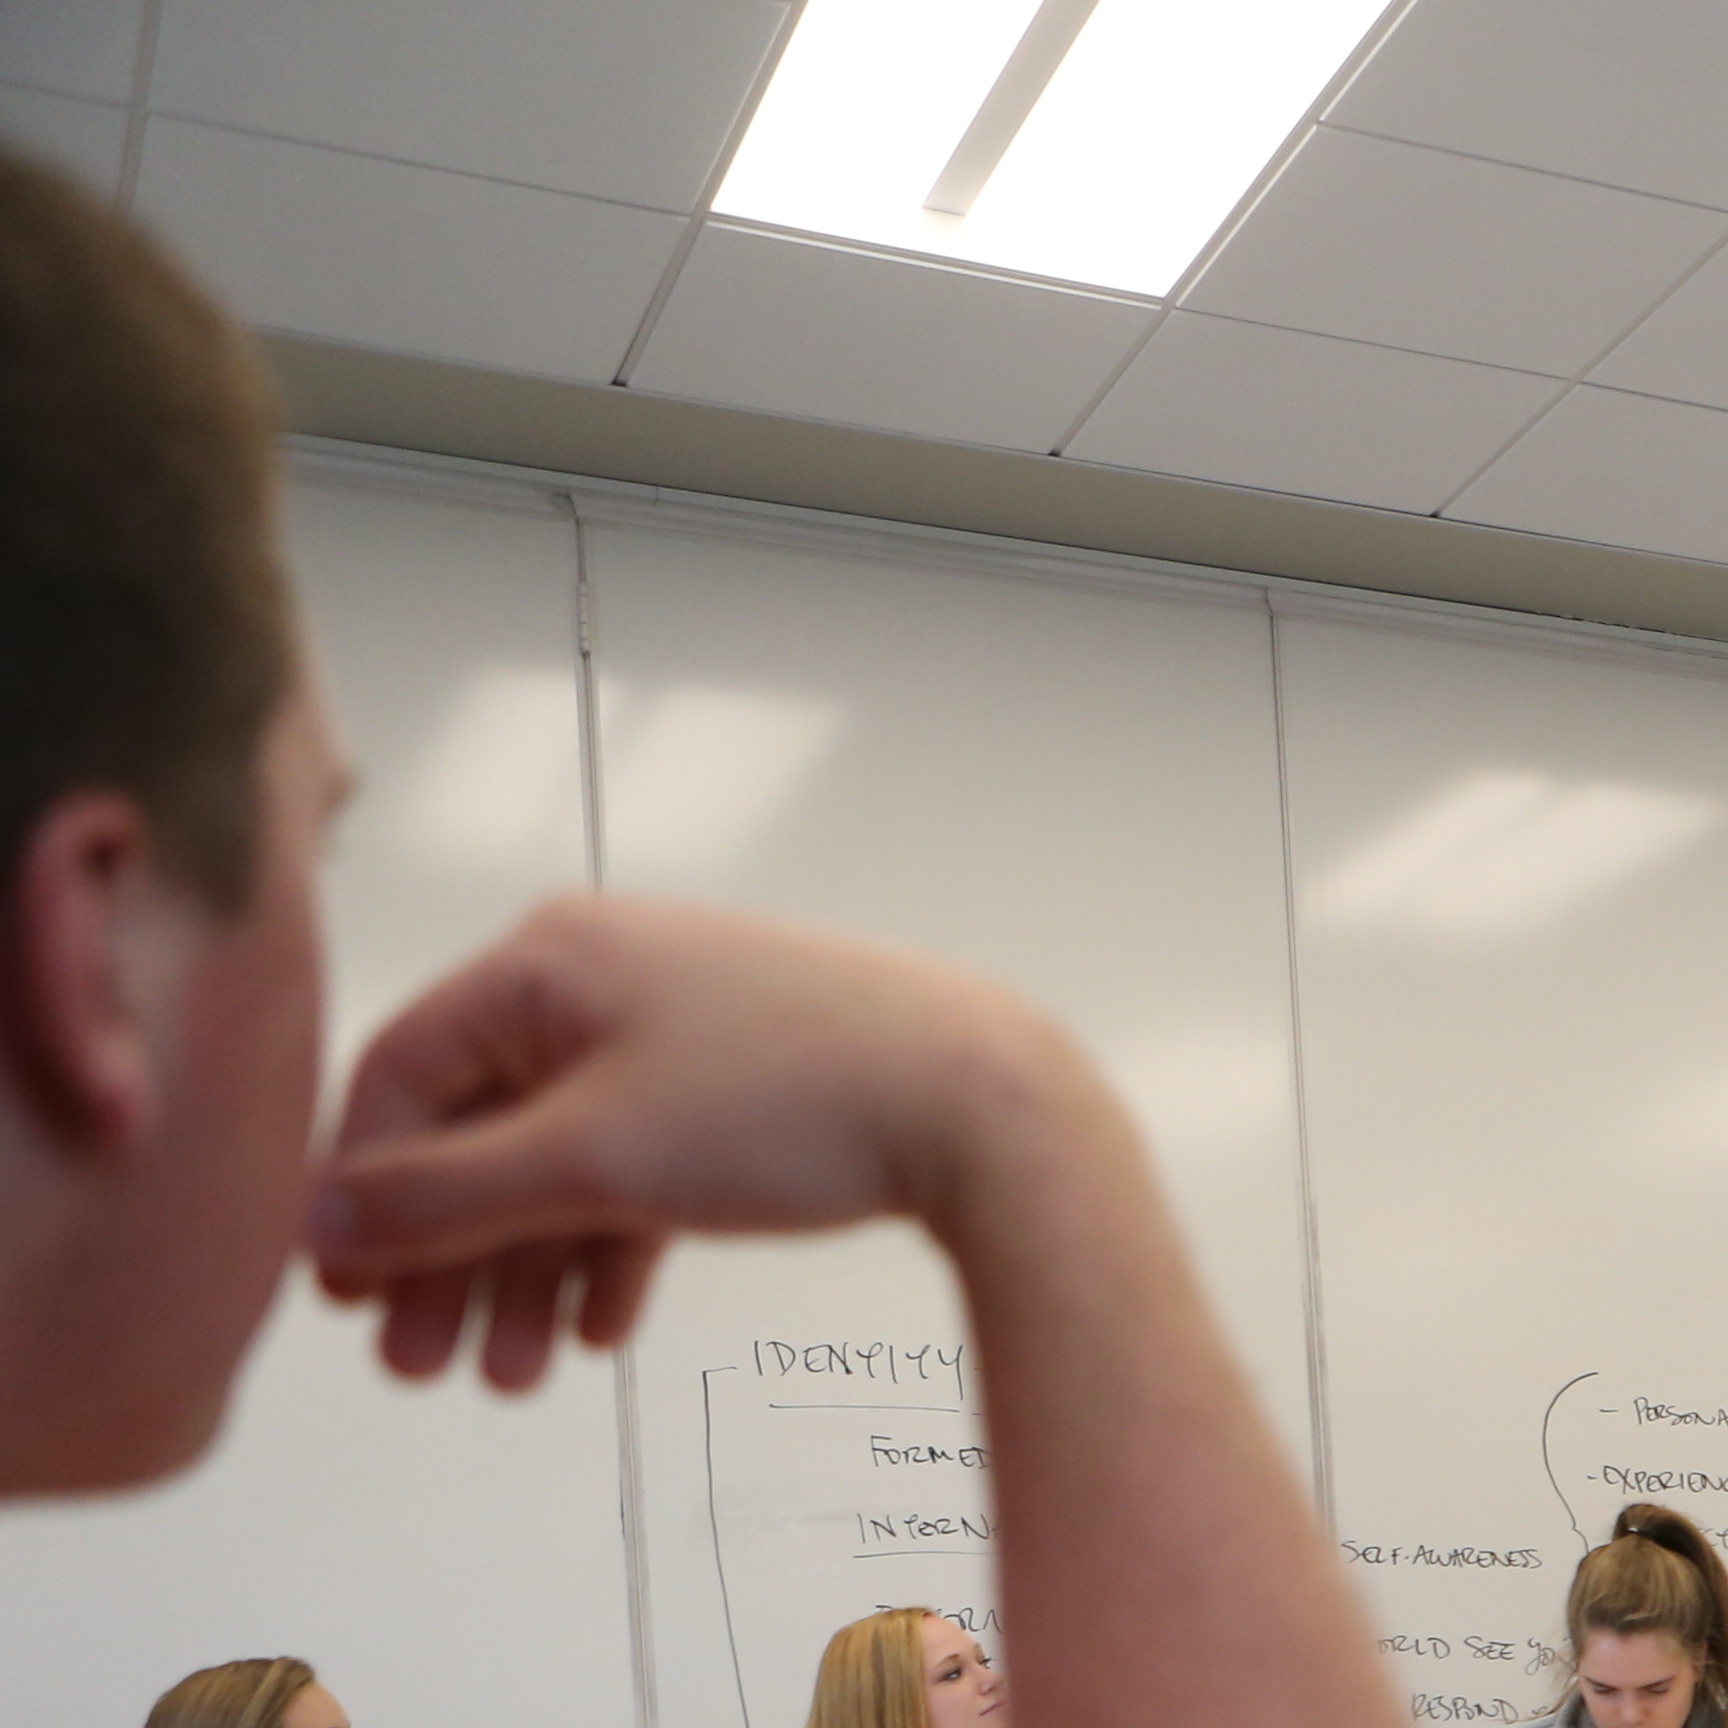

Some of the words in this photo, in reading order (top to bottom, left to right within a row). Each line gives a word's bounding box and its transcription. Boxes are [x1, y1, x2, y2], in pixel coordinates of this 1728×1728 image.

[753, 1339, 965, 1401] IDENTITY
[856, 1512, 1000, 1545] INTERN
[1378, 1635, 1452, 1660] ORLD
[1463, 1636, 1517, 1661] SEE
[1411, 1692, 1520, 1725] RESPOND
